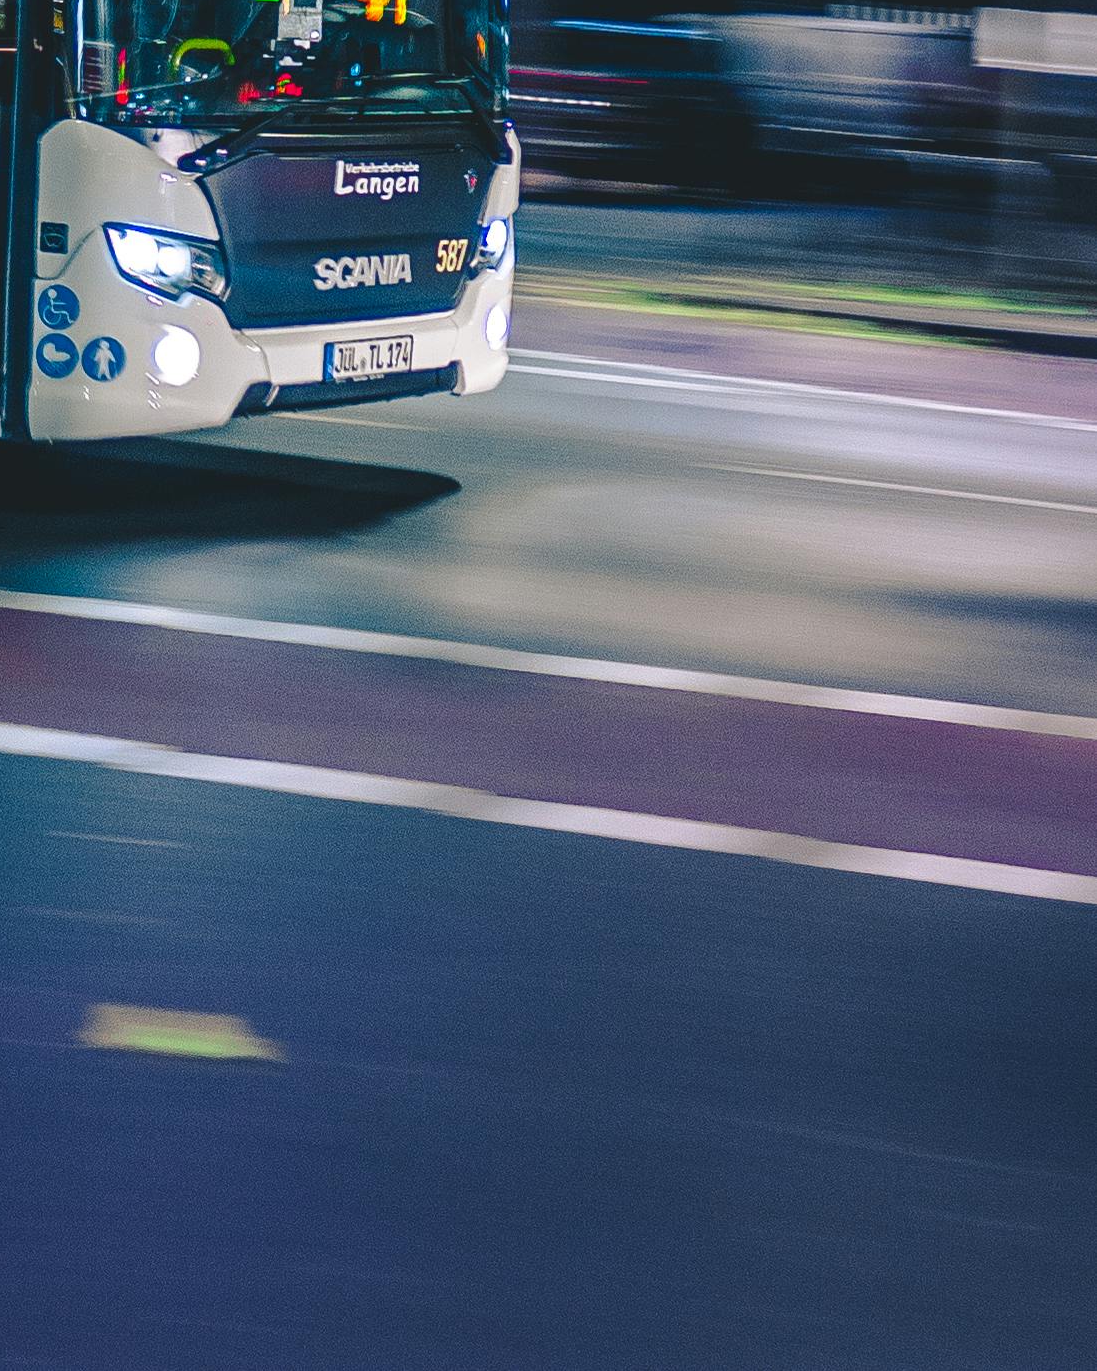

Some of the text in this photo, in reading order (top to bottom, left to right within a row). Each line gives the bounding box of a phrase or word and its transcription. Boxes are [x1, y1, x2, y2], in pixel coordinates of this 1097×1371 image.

[334, 159, 420, 201] Langen
[345, 161, 420, 174] Verkehrsbetriebe
[313, 253, 413, 291] SCANIA
[435, 238, 469, 274] 587
[334, 340, 410, 374] JÜL TL 174
